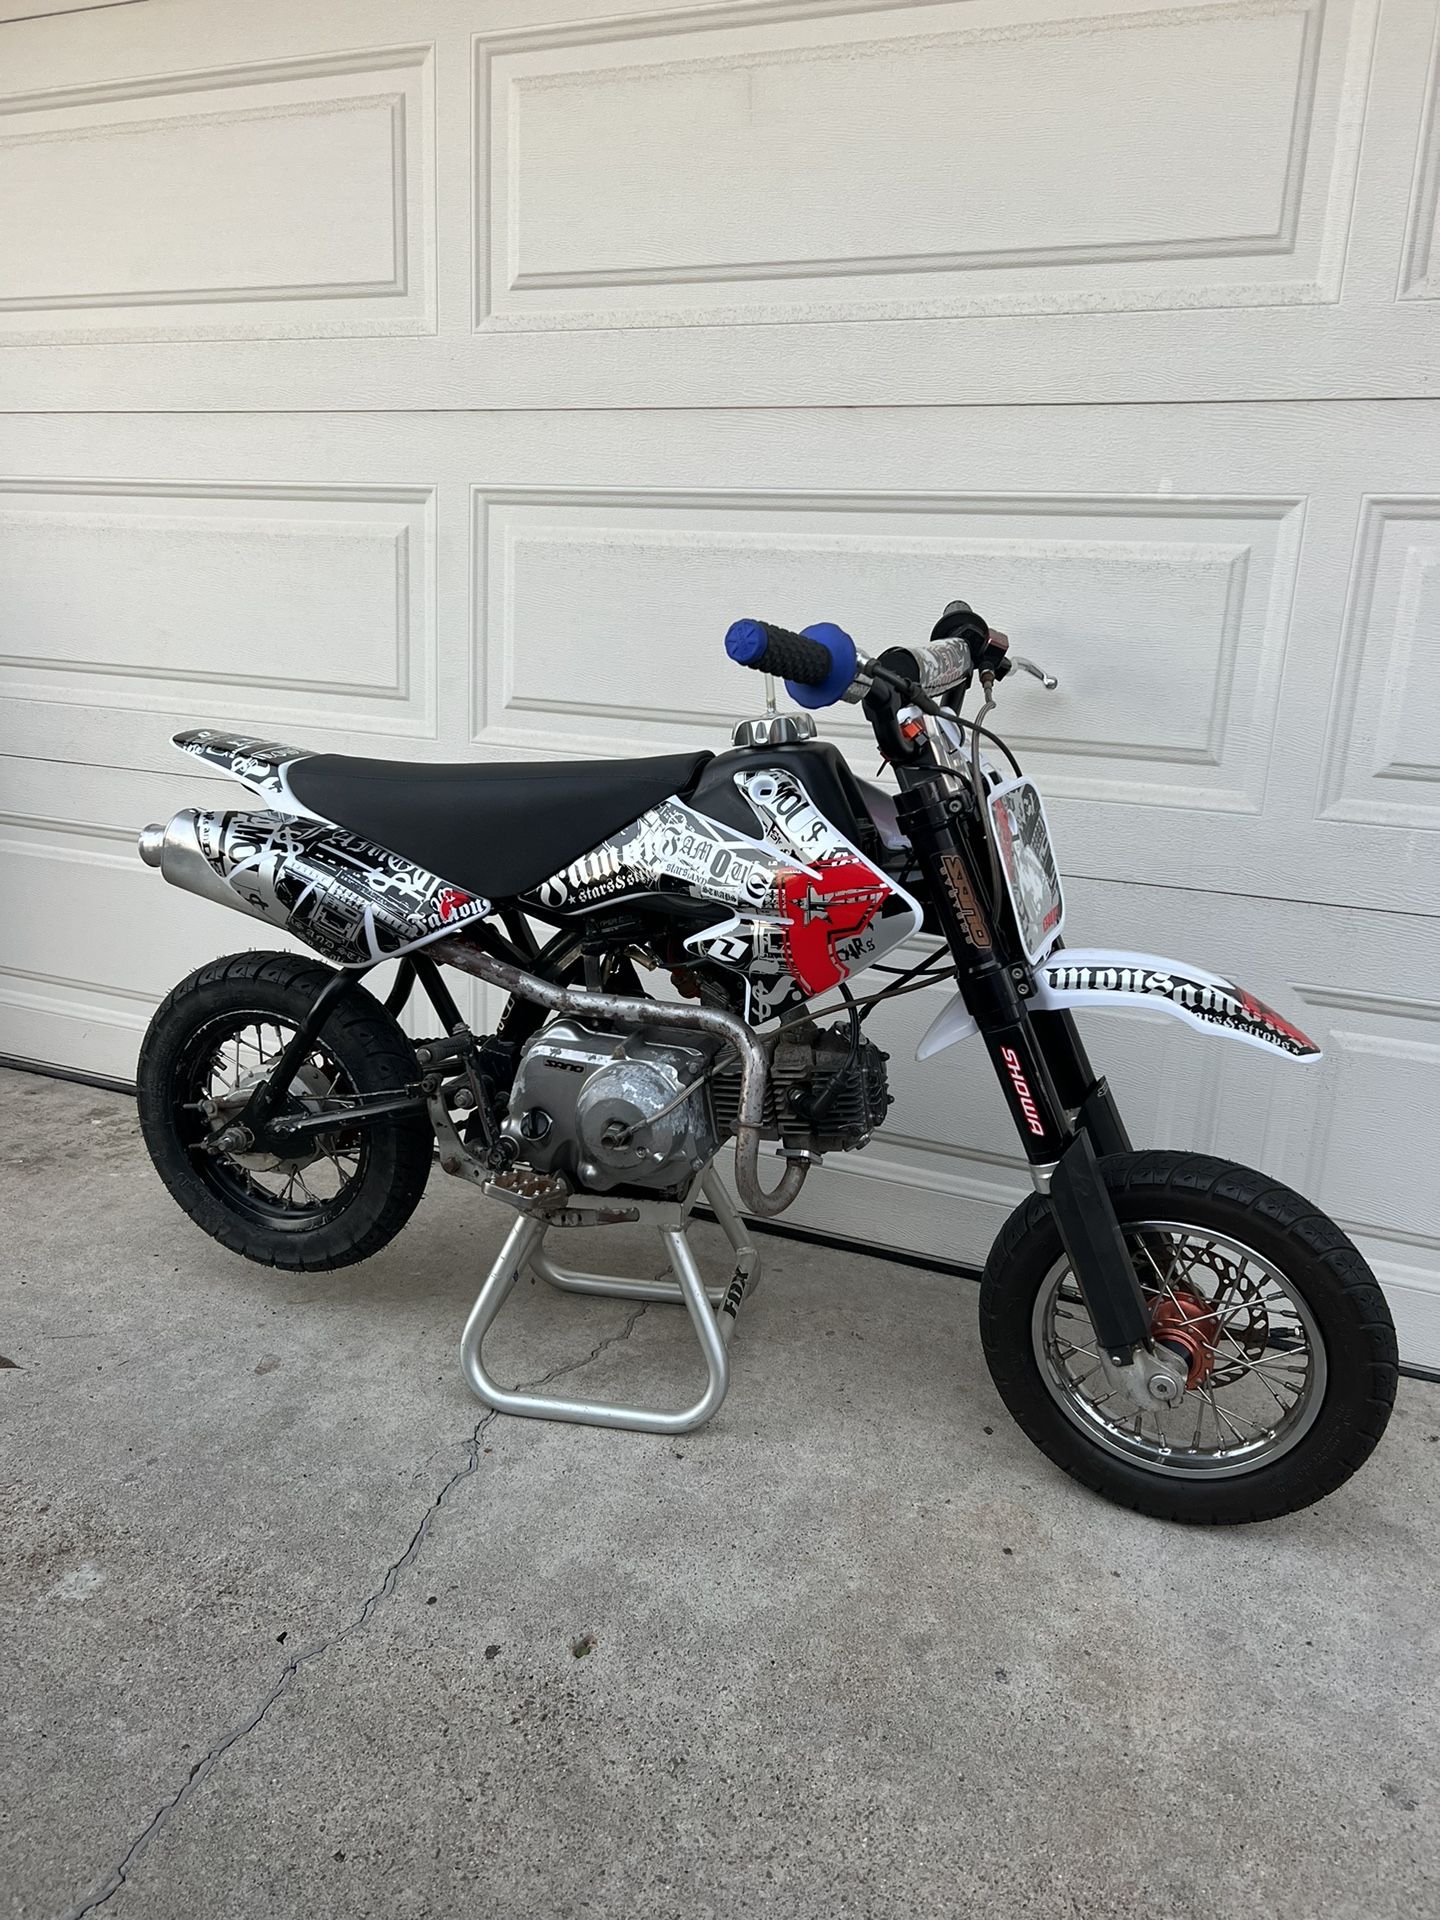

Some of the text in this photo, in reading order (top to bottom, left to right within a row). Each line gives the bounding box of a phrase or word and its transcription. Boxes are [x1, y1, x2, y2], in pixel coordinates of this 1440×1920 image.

[661, 826, 769, 900] FAMOUS
[1000, 1045, 1045, 1136] SHOWA
[722, 1265, 749, 1319] FOX
